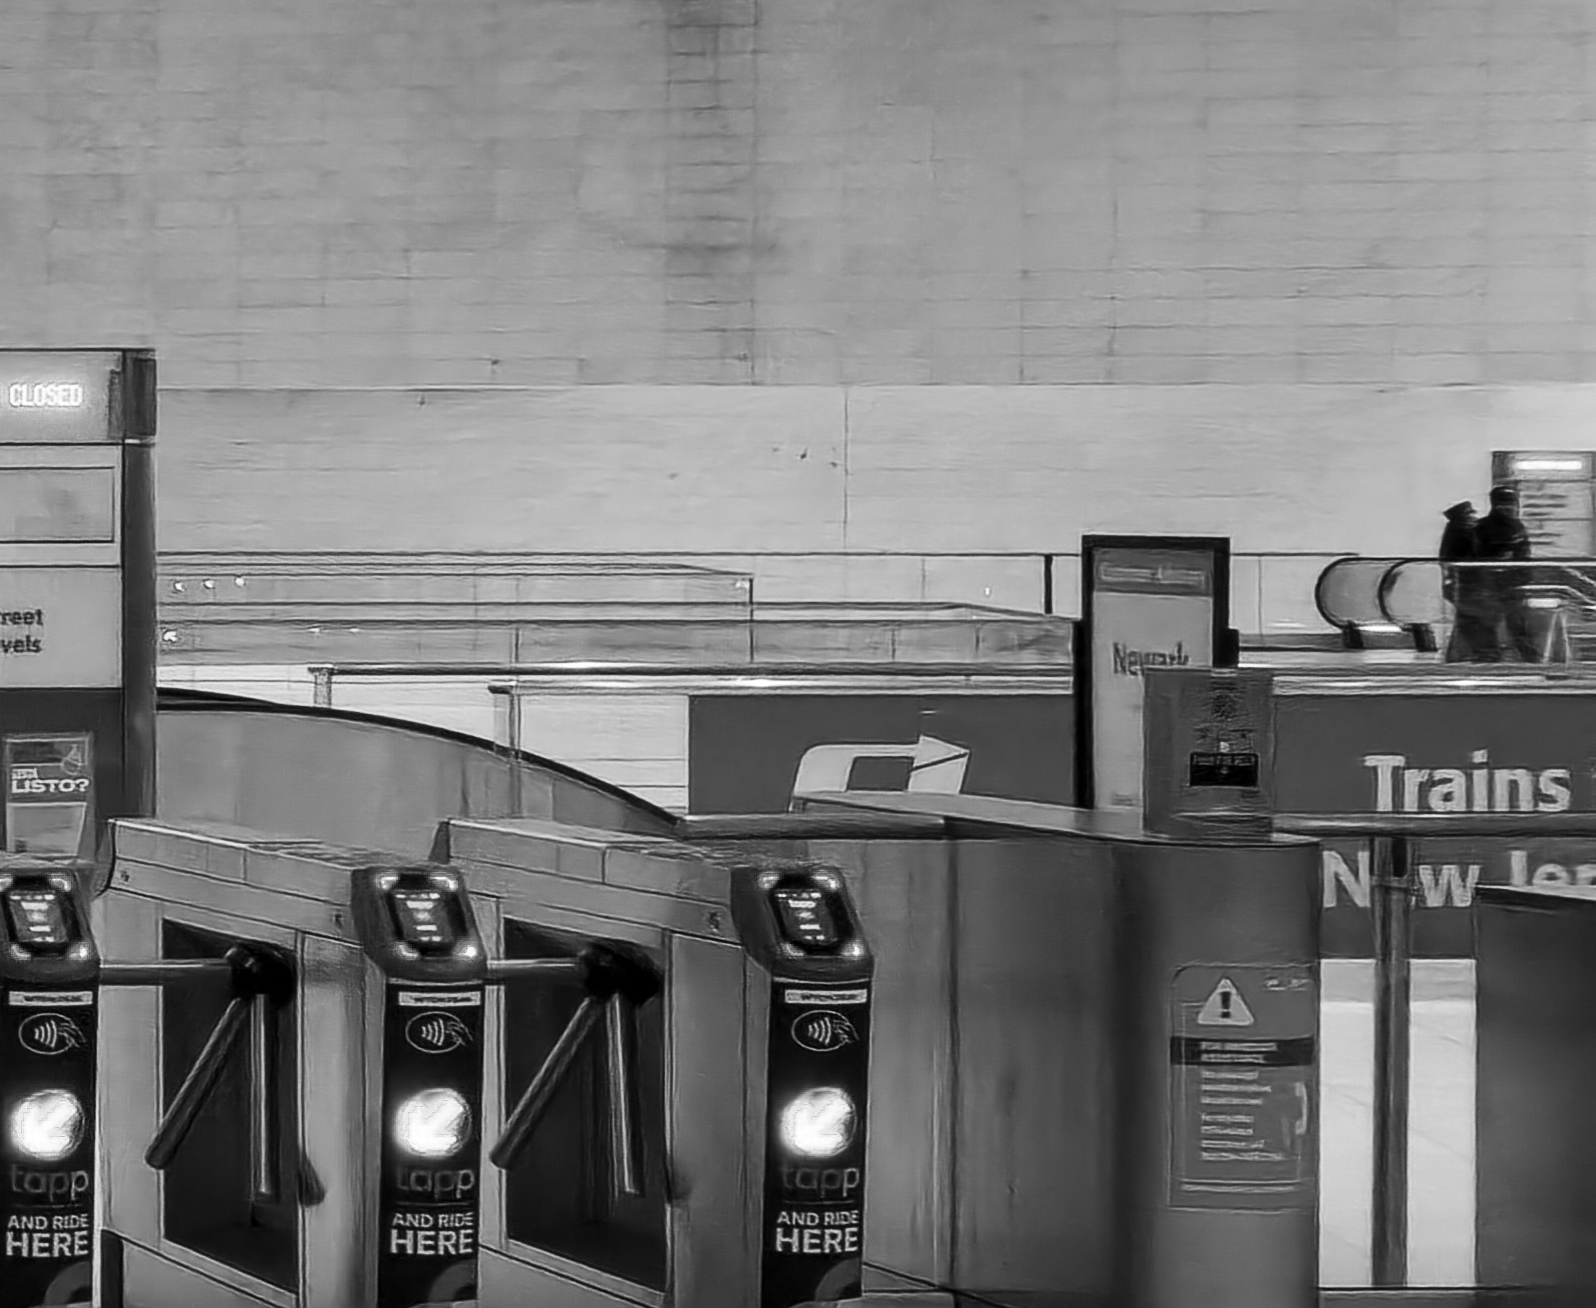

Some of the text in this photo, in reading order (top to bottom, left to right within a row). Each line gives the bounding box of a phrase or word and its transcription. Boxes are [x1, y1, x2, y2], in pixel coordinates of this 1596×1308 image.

[10, 383, 83, 407] CLOSED
[11, 778, 90, 794] LISTO?
[1363, 749, 1571, 812] Trains
[1322, 850, 1482, 908] Nw
[11, 1164, 89, 1202] tapp
[781, 1161, 860, 1199] tapp
[8, 1213, 90, 1230] AND RIDE
[392, 1212, 474, 1228] AND RIDE
[777, 1209, 860, 1226] AND RIDE
[6, 1230, 90, 1258] HERE
[391, 1229, 474, 1255] HERE
[776, 1227, 859, 1254] HERE
